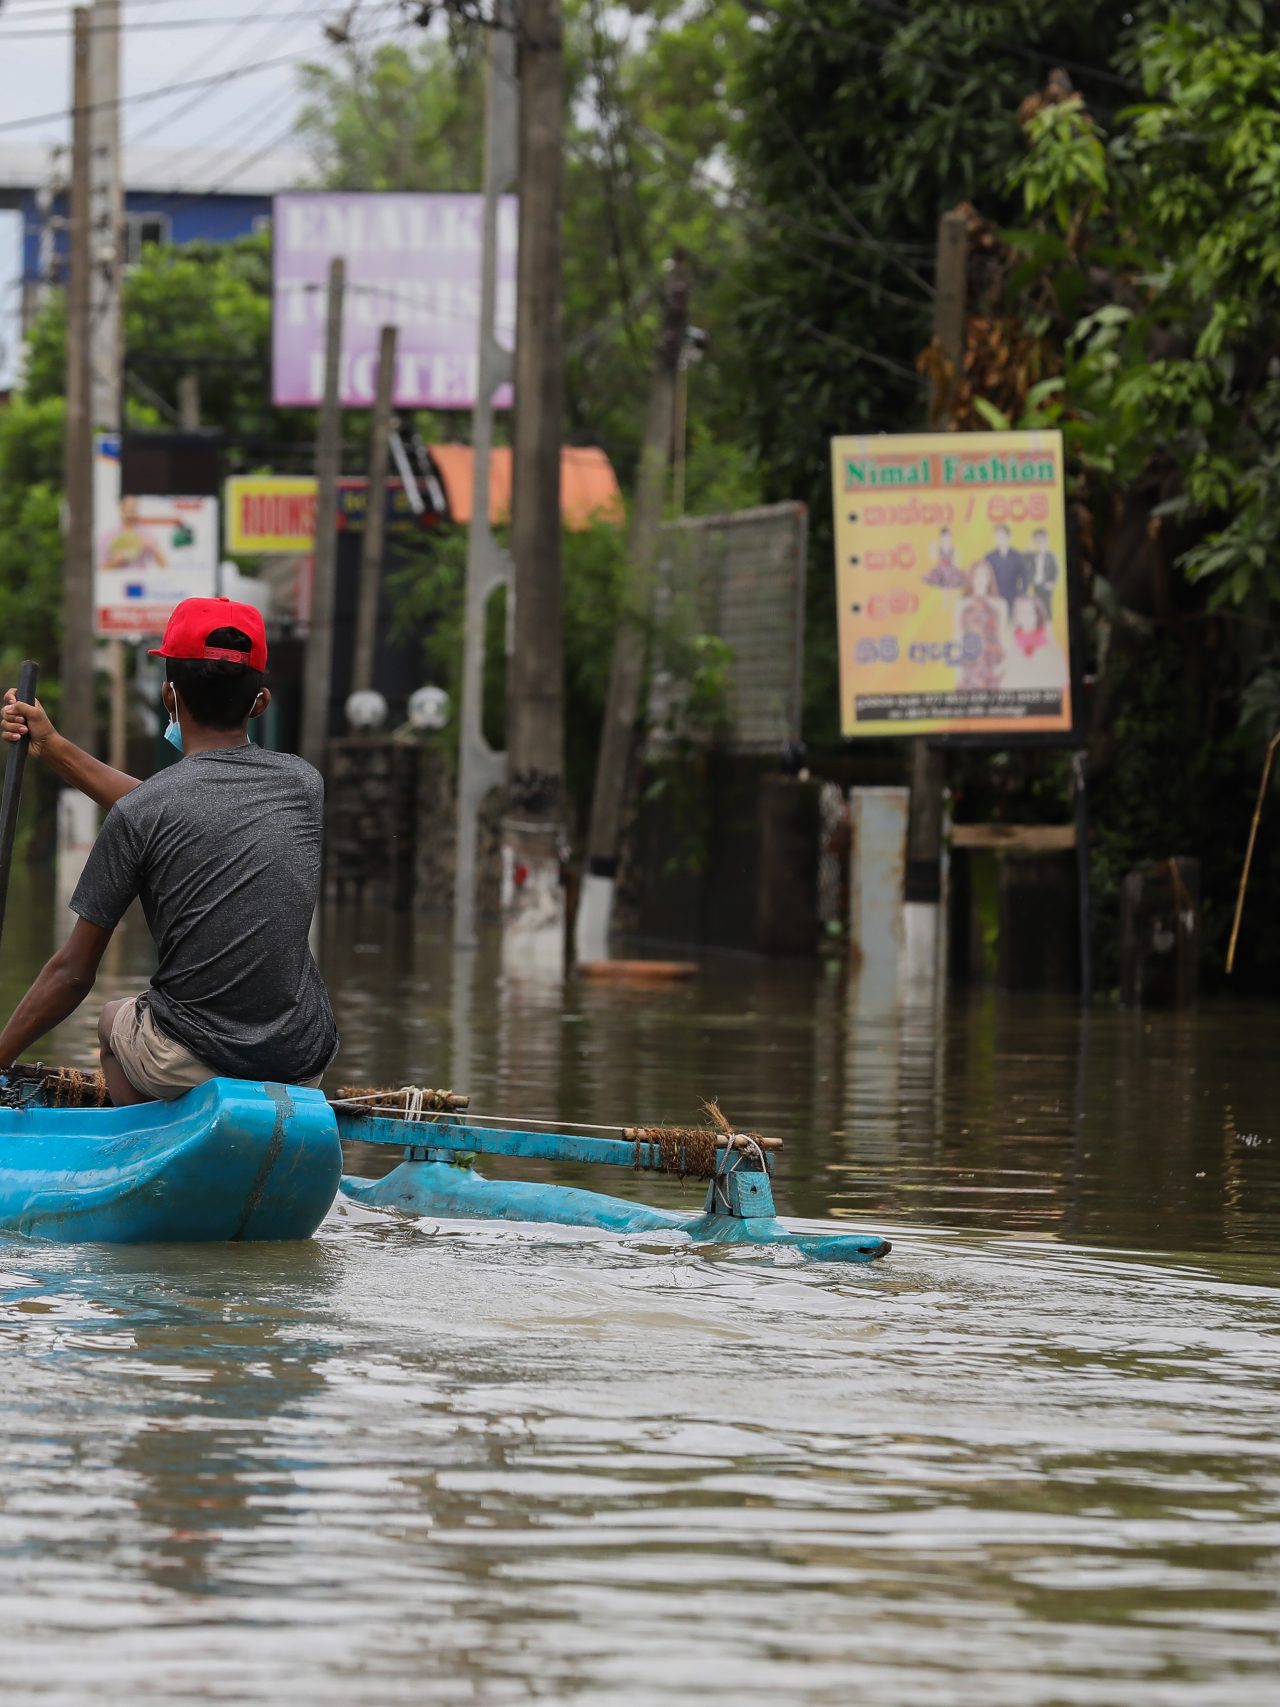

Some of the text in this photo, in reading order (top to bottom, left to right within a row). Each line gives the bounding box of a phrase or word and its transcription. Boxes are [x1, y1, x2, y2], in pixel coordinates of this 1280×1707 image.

[847, 453, 1054, 487] Nimal Fashion
[242, 494, 318, 537] ROOMS
